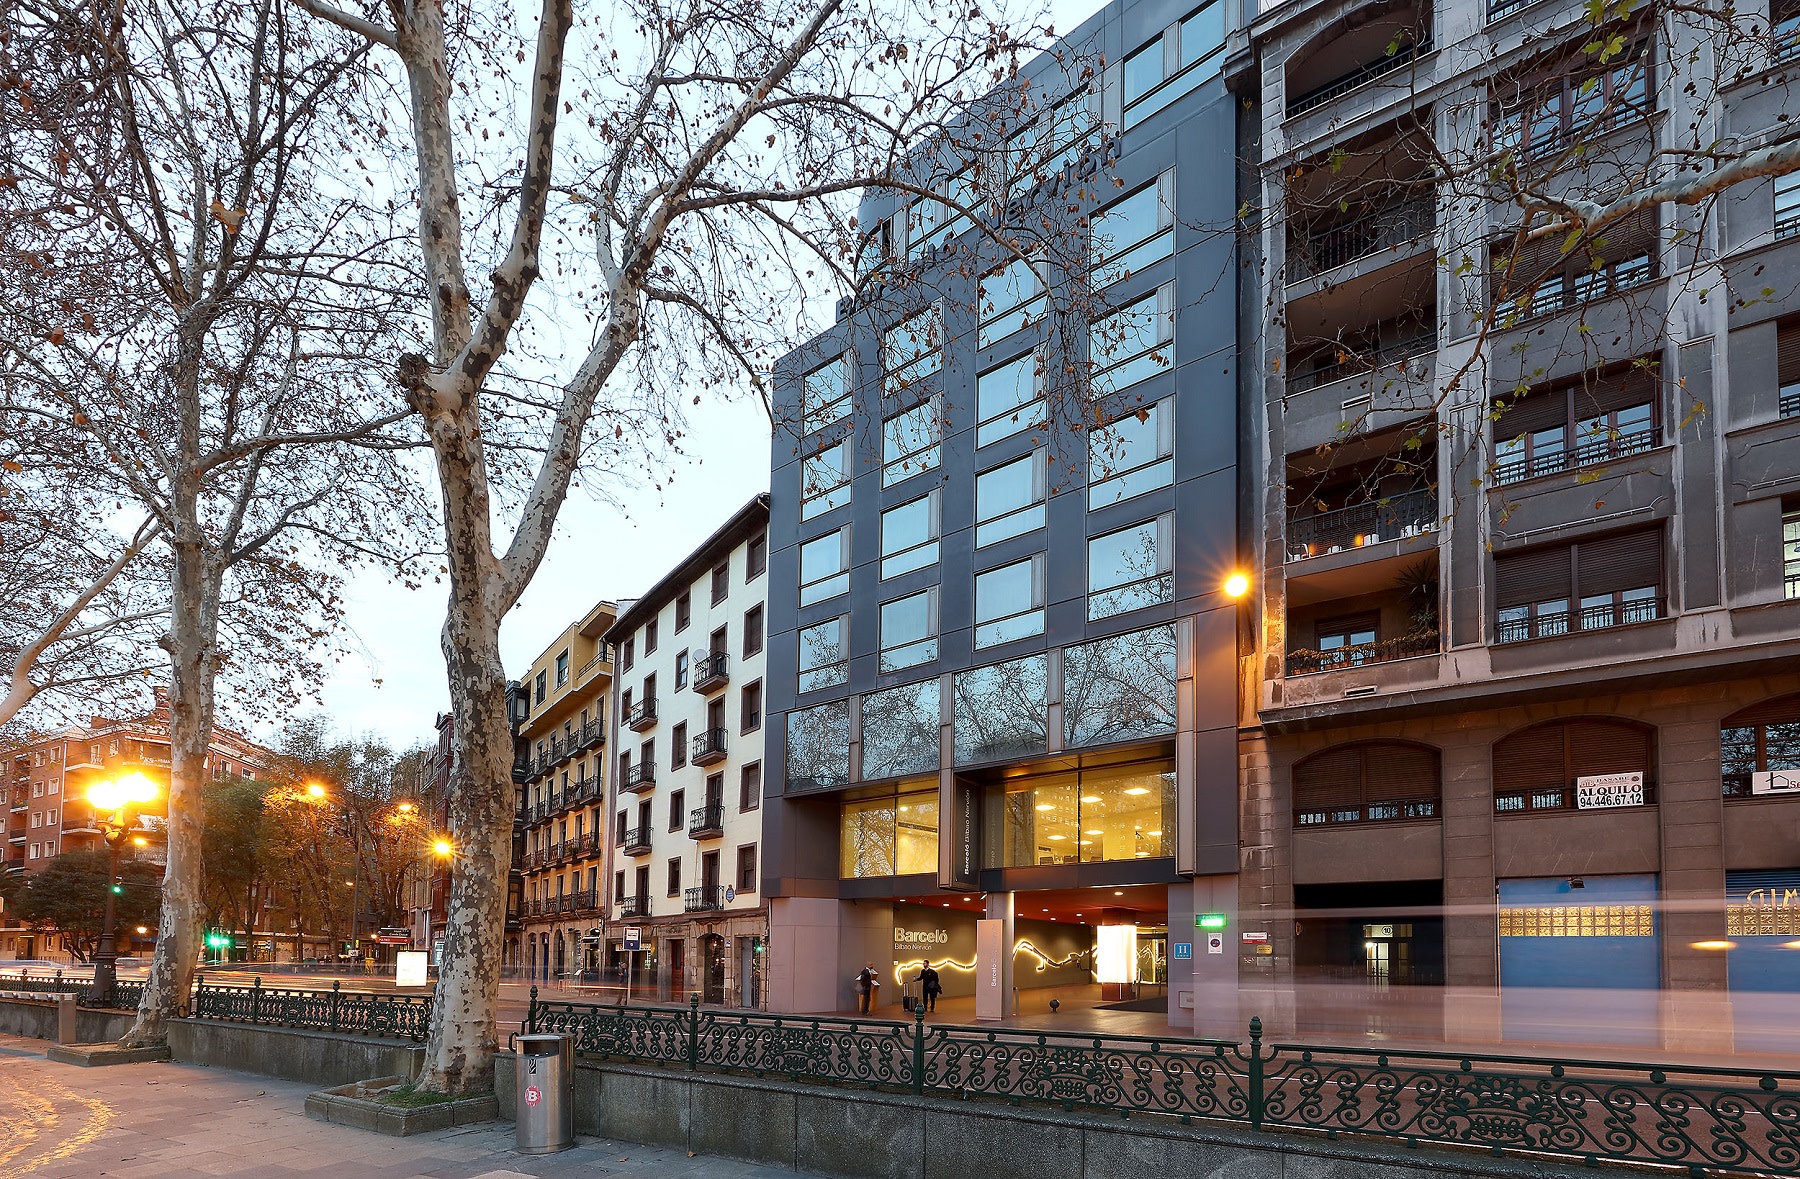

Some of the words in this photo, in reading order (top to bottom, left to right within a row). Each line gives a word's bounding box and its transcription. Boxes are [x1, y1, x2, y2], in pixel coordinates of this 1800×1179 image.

[1579, 784, 1642, 797] ALQUILO
[1580, 793, 1642, 807] 94.446.67.12
[894, 927, 948, 944] Barceló
[912, 943, 932, 951] Nervión
[528, 1090, 538, 1102] B
